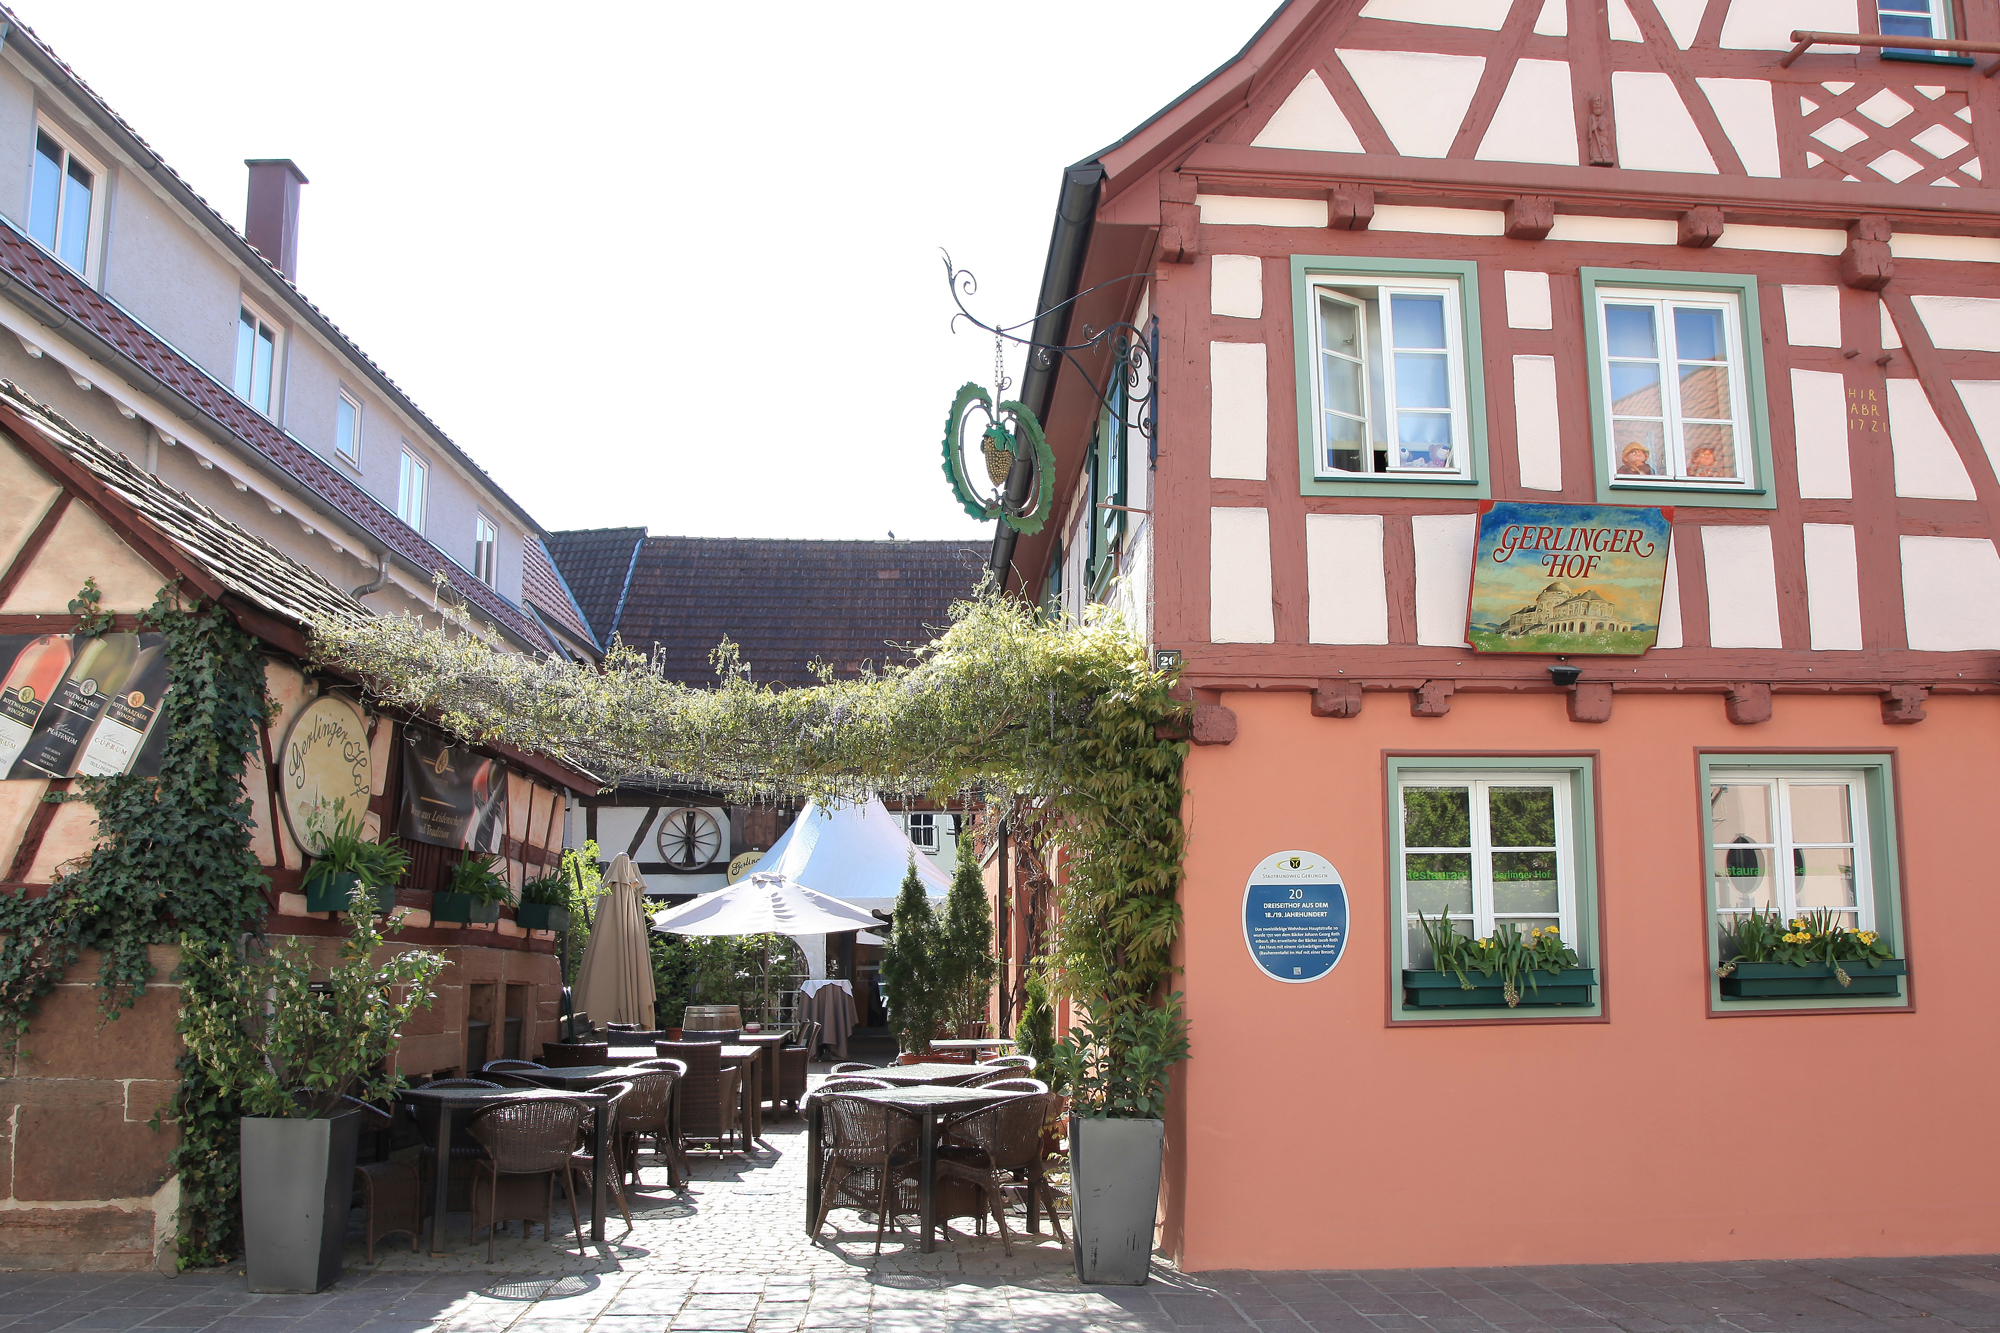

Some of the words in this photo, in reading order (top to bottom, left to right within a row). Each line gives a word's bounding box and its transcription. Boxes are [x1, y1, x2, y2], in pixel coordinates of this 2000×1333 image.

[1850, 402, 1880, 416] ABR
[1492, 524, 1654, 563] GERLINGER
[1542, 554, 1601, 578] HOF
[7, 706, 25, 717] WINZER
[68, 699, 88, 712] WINZER
[112, 701, 148, 721] BOTTWARTALER
[116, 710, 136, 722] WINZER
[47, 727, 78, 745] PLATINUM
[41, 752, 58, 762] RIESLING
[289, 714, 349, 789] Gerlinger
[344, 741, 370, 798] Hof
[427, 824, 449, 839] Tradition
[1494, 870, 1532, 880] Gerlinger
[1534, 870, 1551, 878] Hof
[1288, 889, 1303, 900] 20
